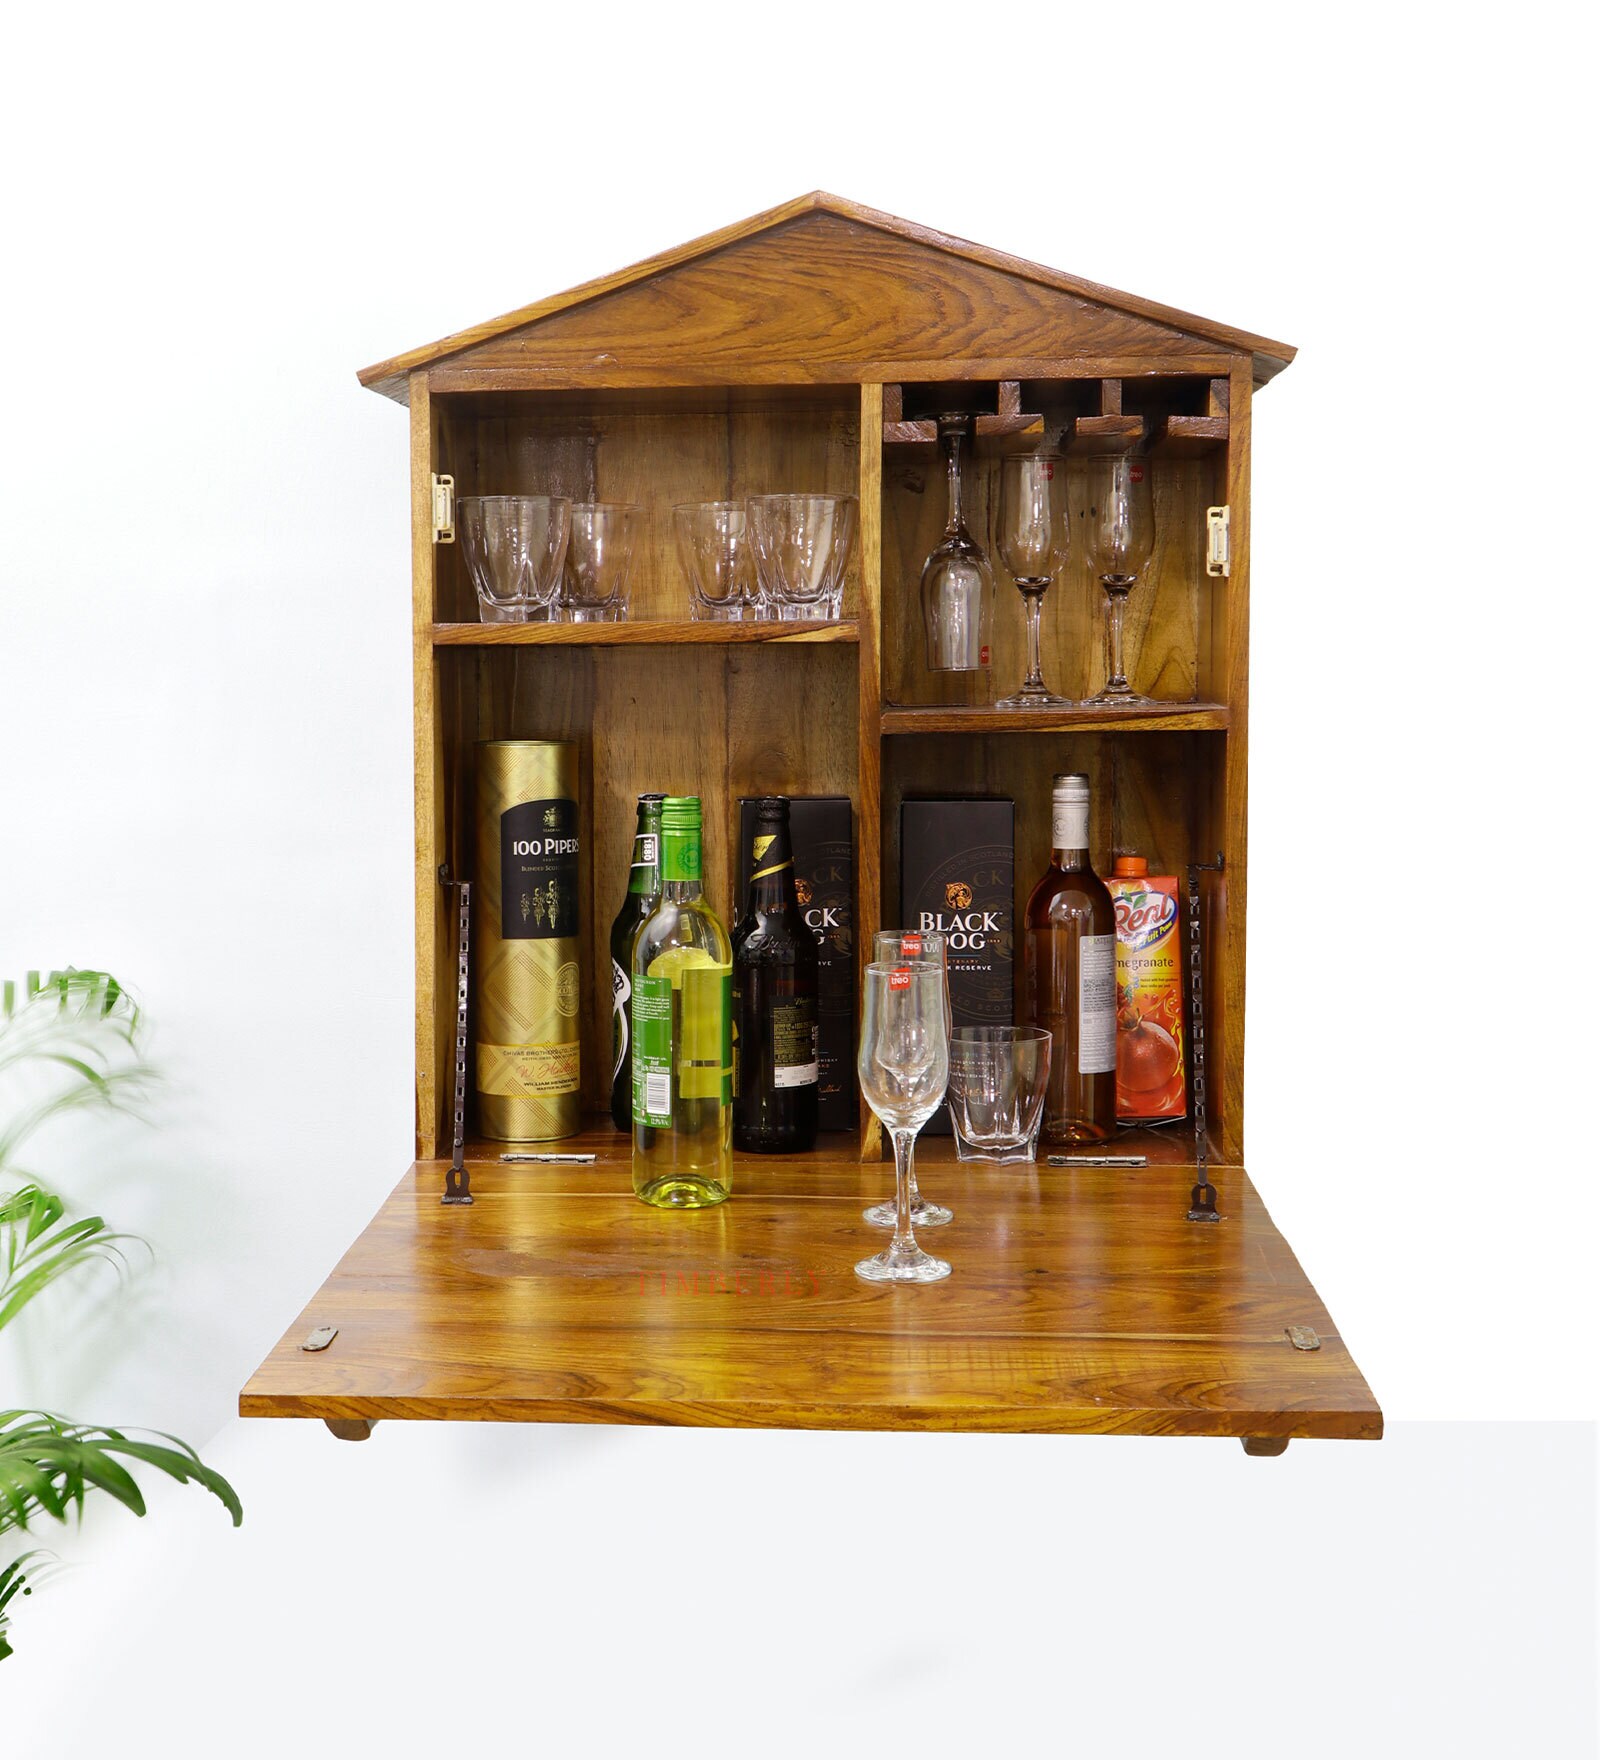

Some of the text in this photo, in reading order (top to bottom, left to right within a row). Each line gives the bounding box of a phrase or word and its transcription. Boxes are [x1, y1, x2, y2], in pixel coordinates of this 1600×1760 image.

[513, 840, 542, 856] 100
[643, 839, 652, 861] 1880
[919, 911, 1000, 932] BLACK
[1117, 958, 1174, 971] megranate
[891, 976, 909, 985] treo
